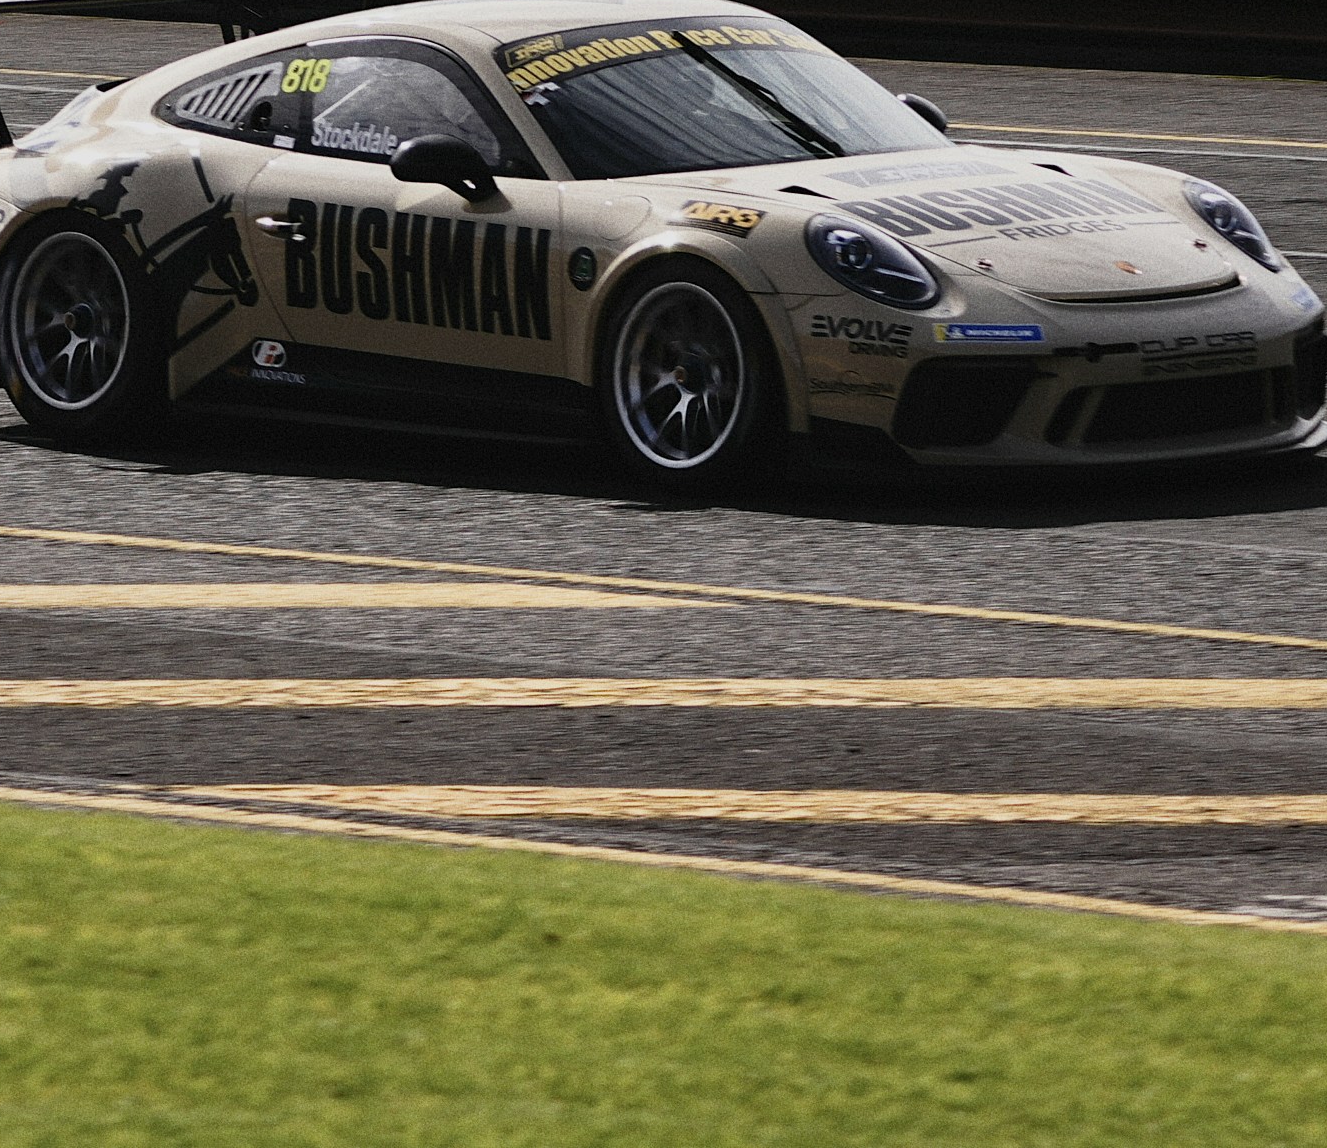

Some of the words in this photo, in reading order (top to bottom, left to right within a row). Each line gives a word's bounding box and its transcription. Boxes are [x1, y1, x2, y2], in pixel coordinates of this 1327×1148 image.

[281, 58, 332, 93] 818
[507, 31, 659, 92] nnovation
[646, 26, 732, 49] Rce
[721, 25, 778, 47] Car
[310, 119, 398, 155] Stockdale
[831, 179, 1166, 238] BUSHMAN
[996, 219, 1127, 241] FRIDGES
[285, 198, 551, 341] BUSHMAN
[811, 315, 914, 346] EVOLVE
